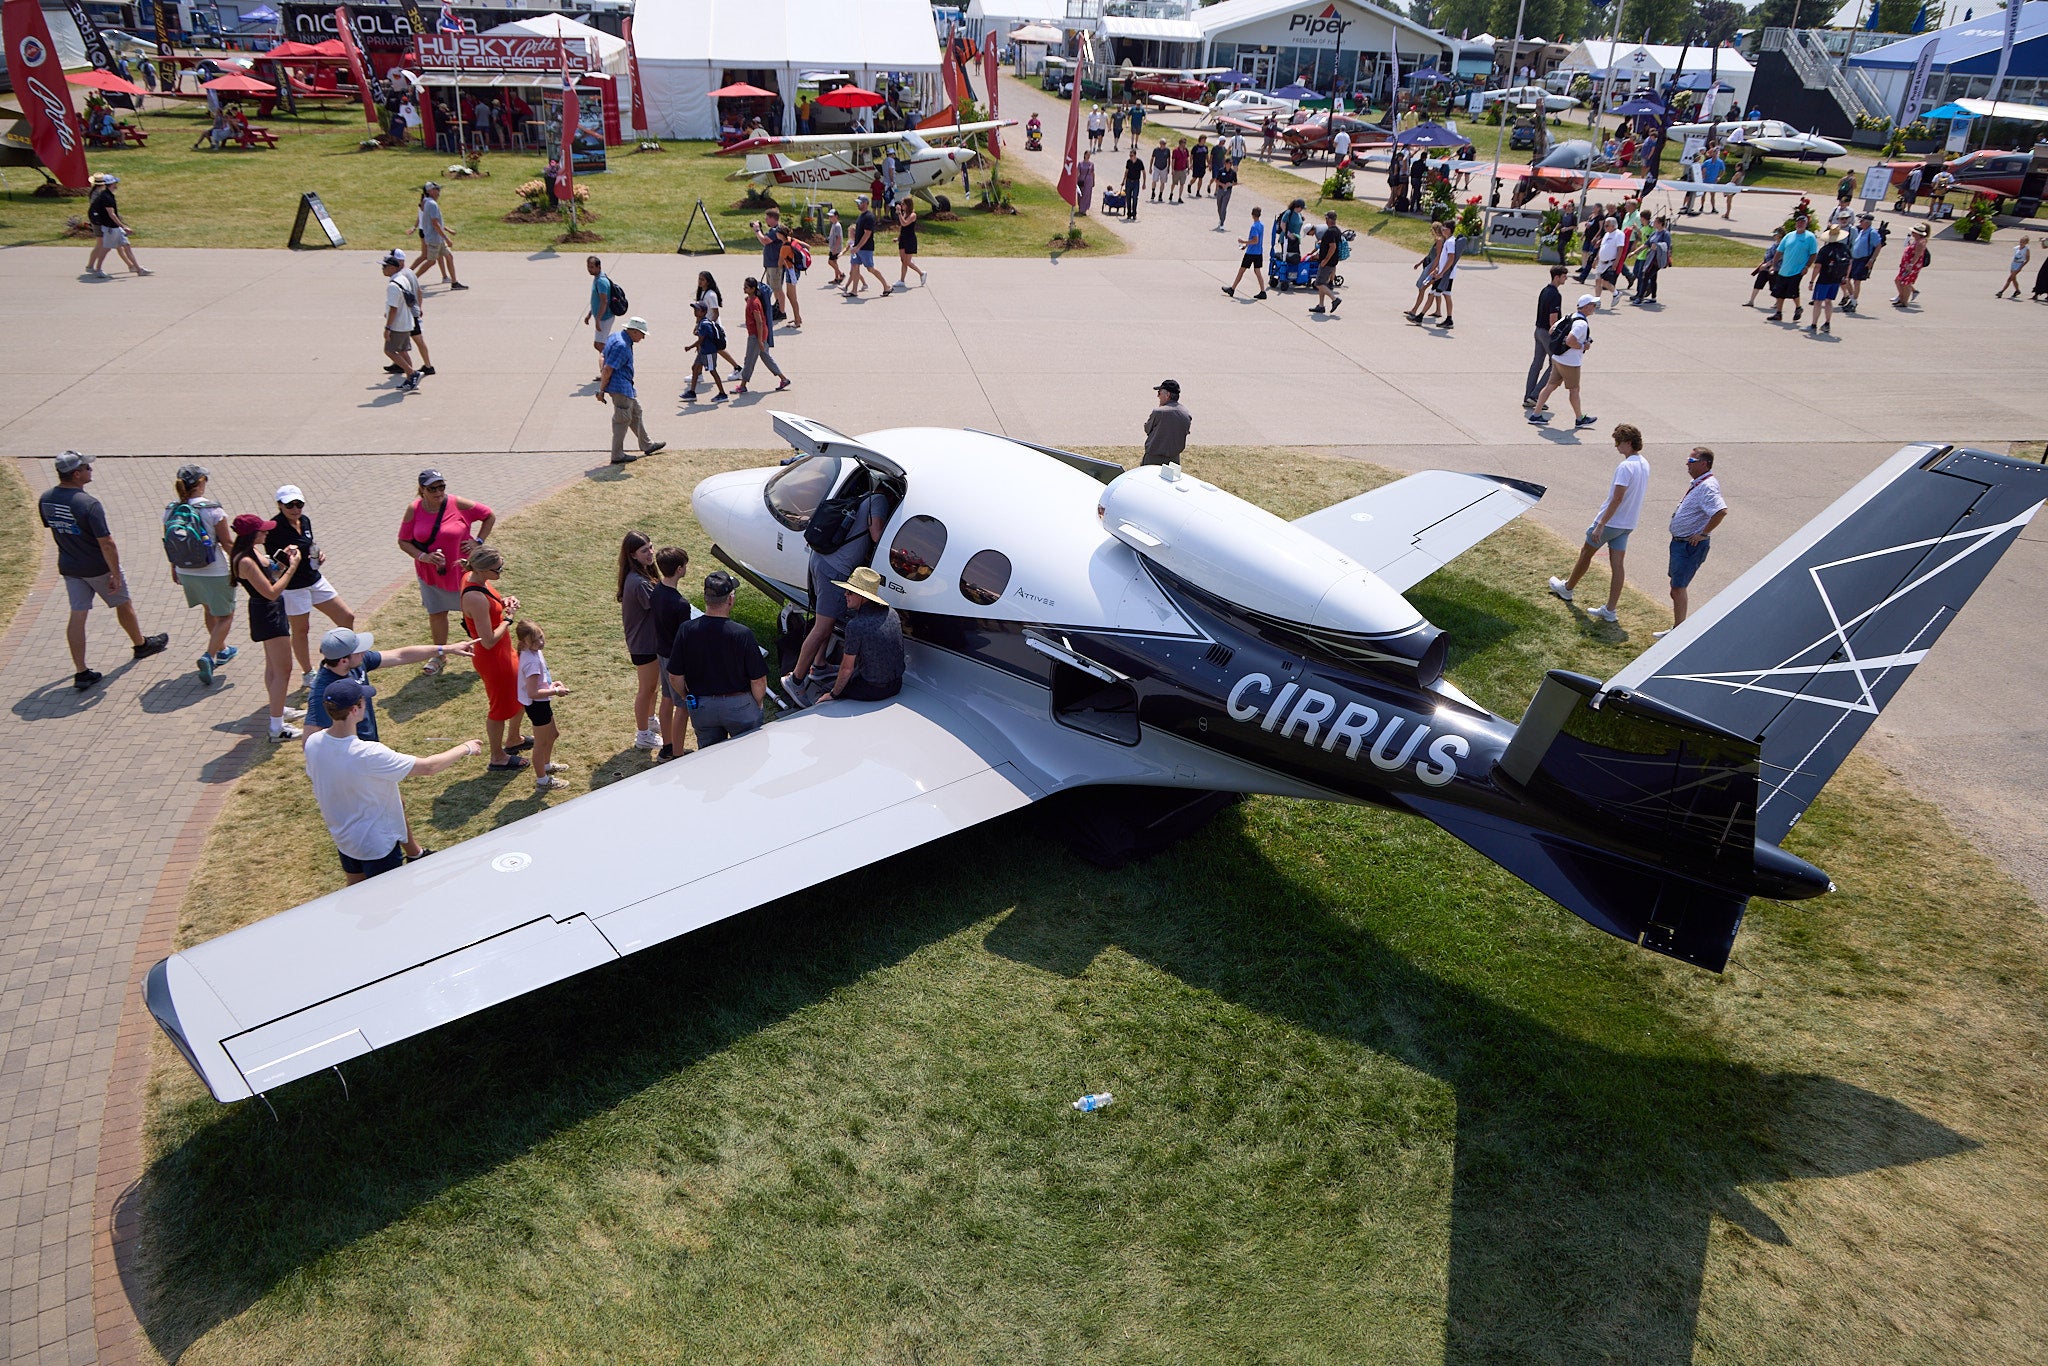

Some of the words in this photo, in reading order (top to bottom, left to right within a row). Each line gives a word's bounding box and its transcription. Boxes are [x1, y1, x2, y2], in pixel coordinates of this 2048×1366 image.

[1289, 14, 1352, 36] Piper
[418, 37, 518, 56] HUSKY
[515, 38, 557, 57] Pitts
[420, 54, 470, 66] AVIAT
[473, 56, 556, 68] AIRCRAFT
[27, 76, 76, 153] Pitts
[792, 168, 831, 184] N75HC
[1491, 224, 1535, 239] Piper
[1226, 672, 1471, 788] CIRRUS
